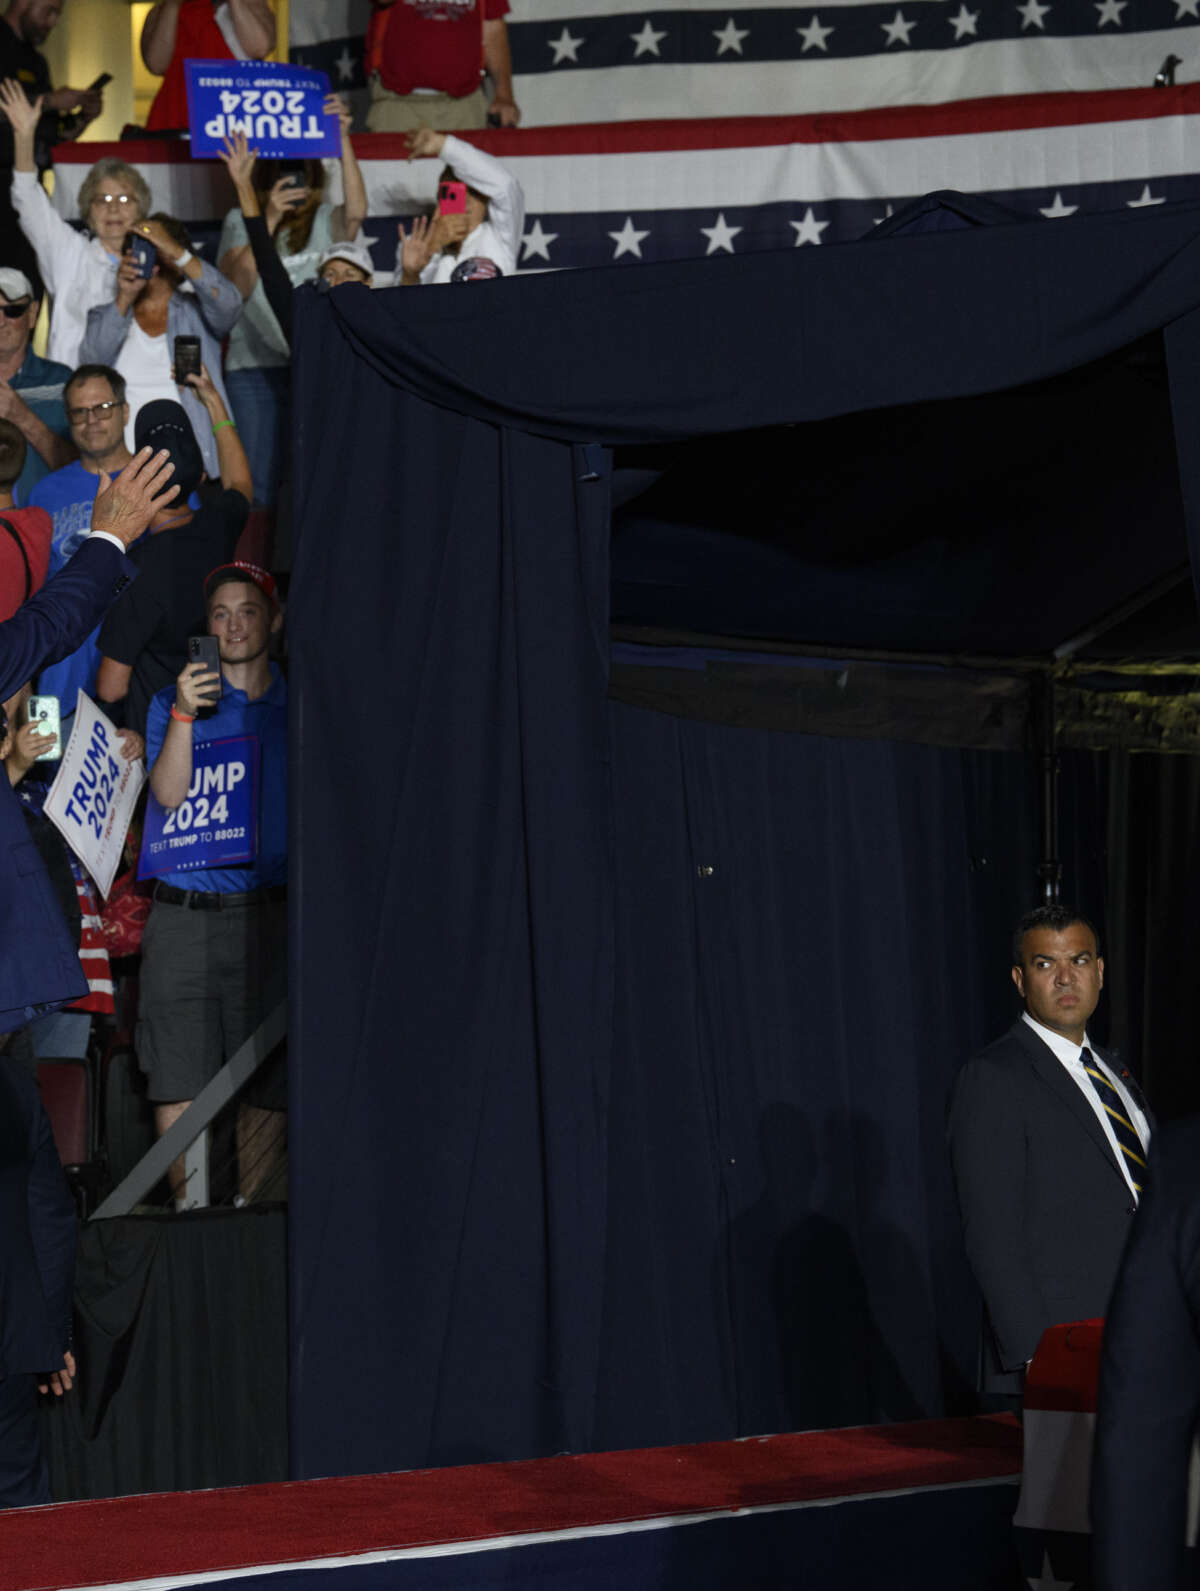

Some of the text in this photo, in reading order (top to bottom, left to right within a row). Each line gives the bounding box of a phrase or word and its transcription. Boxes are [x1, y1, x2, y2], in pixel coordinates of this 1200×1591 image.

[219, 90, 305, 114] 2024
[204, 114, 325, 139] TRUMP
[65, 720, 109, 827] TRUMP
[187, 761, 246, 798] UMP
[87, 755, 120, 840] 2024
[162, 794, 229, 835] 2024
[150, 826, 246, 855] TEXT TRUMP TO 88022
